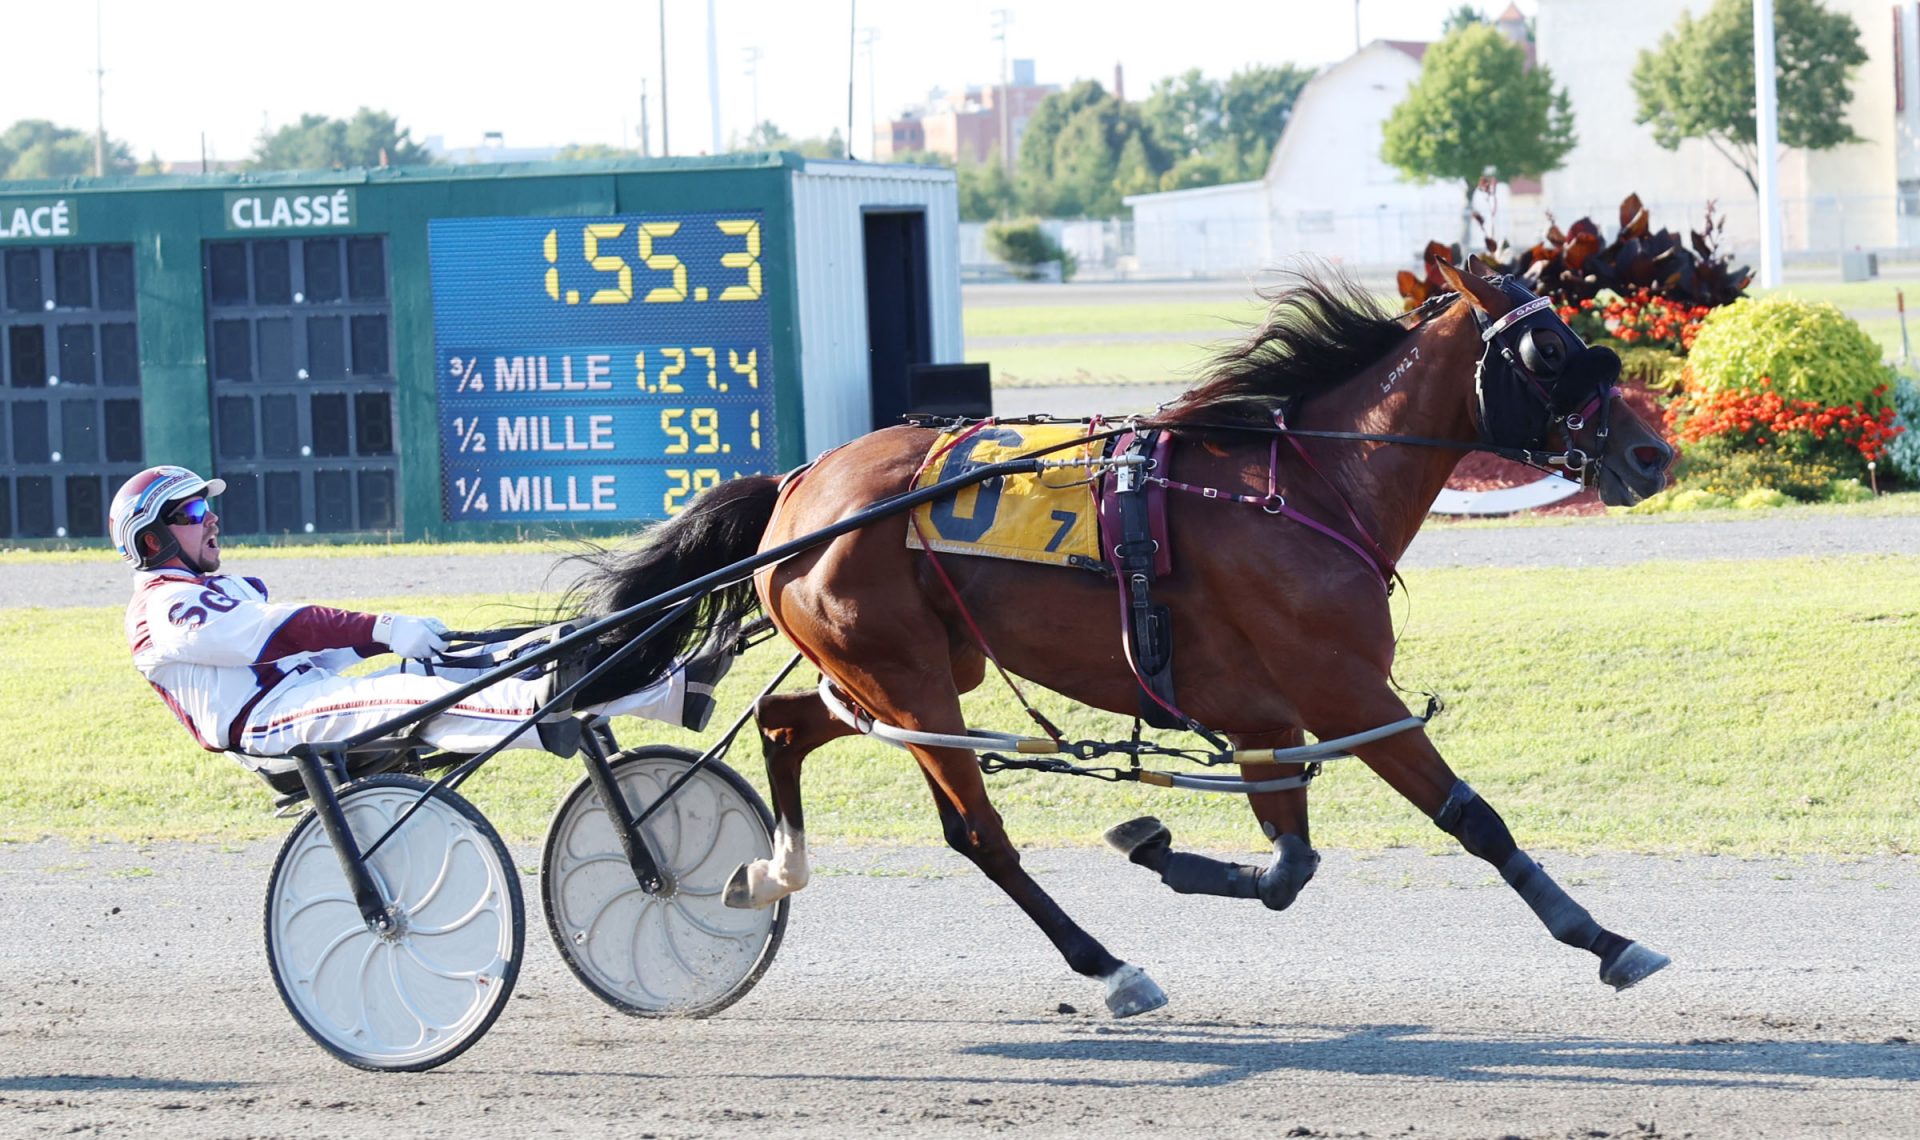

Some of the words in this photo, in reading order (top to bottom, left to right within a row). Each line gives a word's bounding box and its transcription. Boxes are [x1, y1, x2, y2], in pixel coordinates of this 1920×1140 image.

[231, 189, 350, 228] CLASSÉ
[543, 220, 762, 304] 1.55.3
[494, 354, 614, 392] MILLE
[635, 347, 758, 394] 1.27.4
[497, 414, 616, 452] MILLE
[660, 407, 761, 455] 59.1
[500, 475, 618, 513] MILLE
[930, 428, 1024, 542] 6
[1044, 510, 1077, 552] 7
